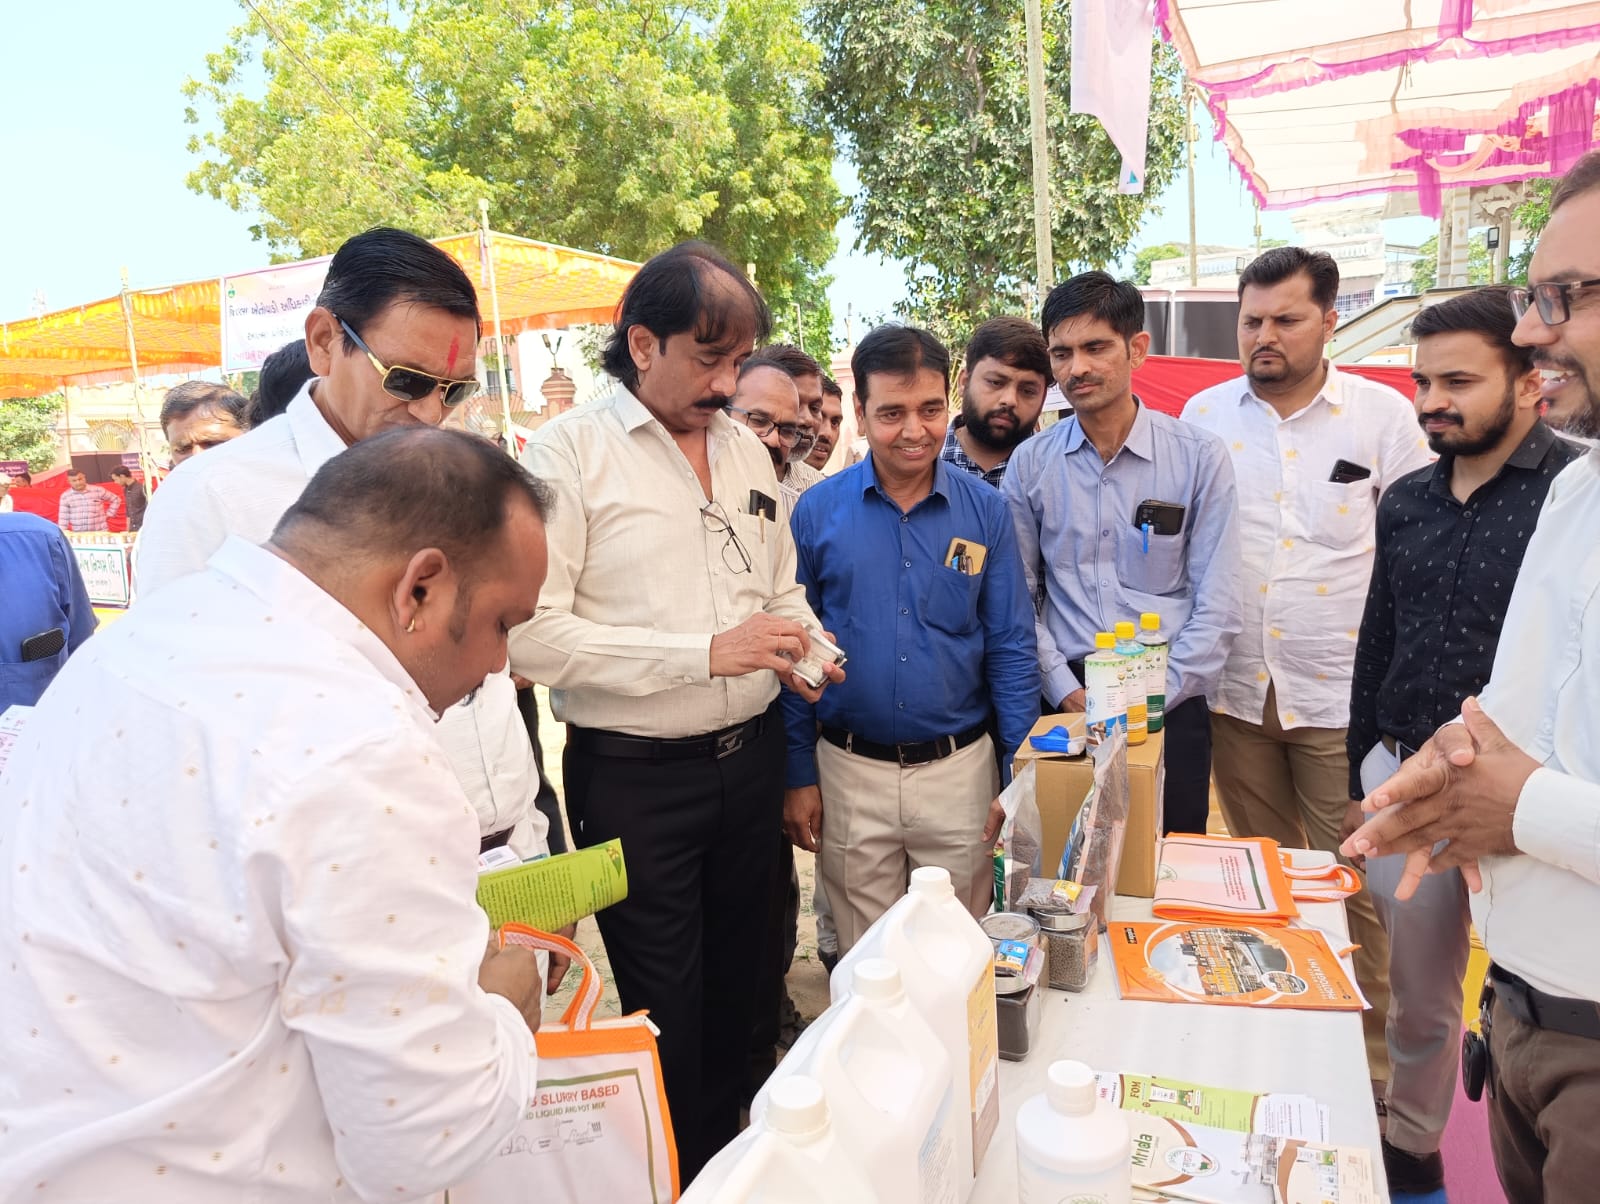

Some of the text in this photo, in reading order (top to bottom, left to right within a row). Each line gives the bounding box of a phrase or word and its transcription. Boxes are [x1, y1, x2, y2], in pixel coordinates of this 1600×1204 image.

[541, 1091, 578, 1106] SLURRY
[581, 1084, 620, 1100] BASED
[535, 1107, 563, 1119] LIQUID
[591, 1101, 606, 1111] MIX
[1131, 1133, 1153, 1168] Mrida
